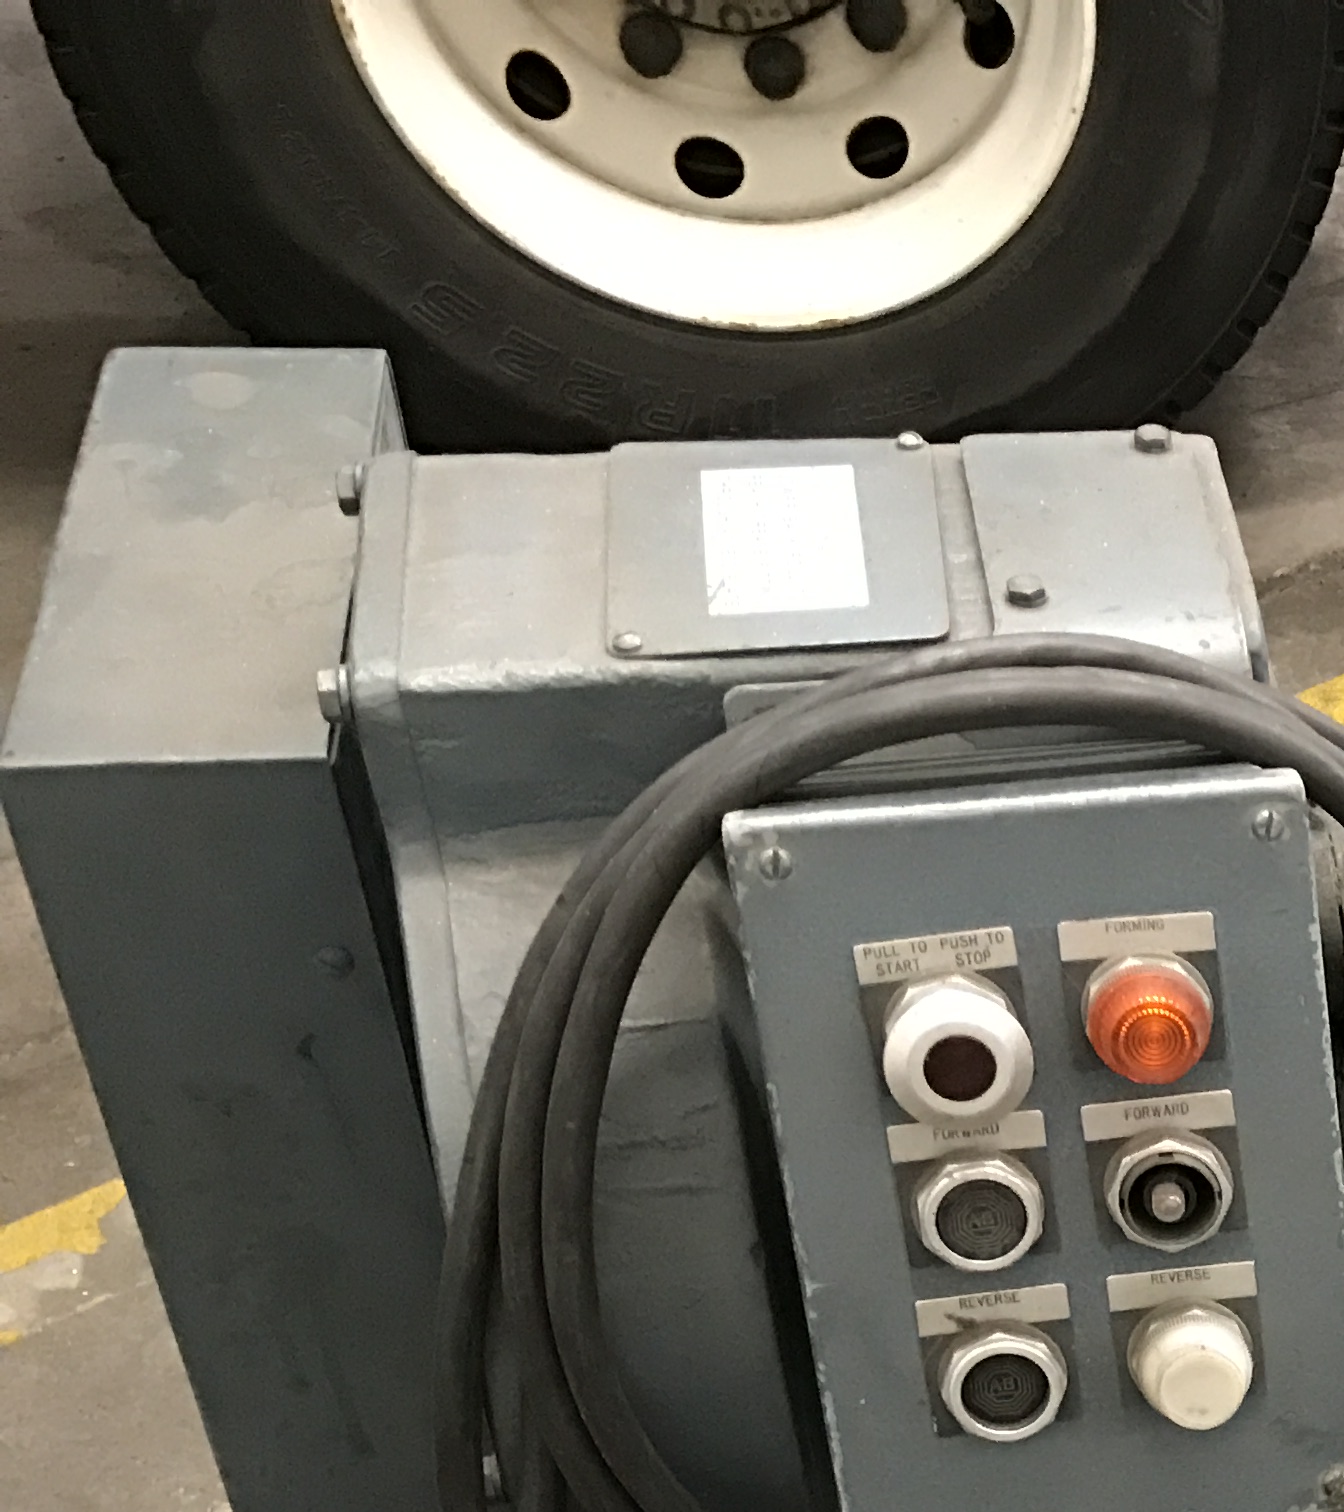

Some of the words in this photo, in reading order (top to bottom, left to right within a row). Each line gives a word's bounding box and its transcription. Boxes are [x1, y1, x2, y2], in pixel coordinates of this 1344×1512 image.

[1104, 918, 1165, 933] FORMING
[863, 945, 900, 960] PULL
[909, 940, 927, 954] TO
[940, 935, 978, 950] PUSH
[985, 931, 1004, 945] TO
[876, 958, 920, 977] START
[955, 948, 992, 967] STOP
[1124, 1102, 1189, 1121] FORWARD
[1150, 1269, 1212, 1285] REVERSE
[958, 1292, 1021, 1310] REVERSE
